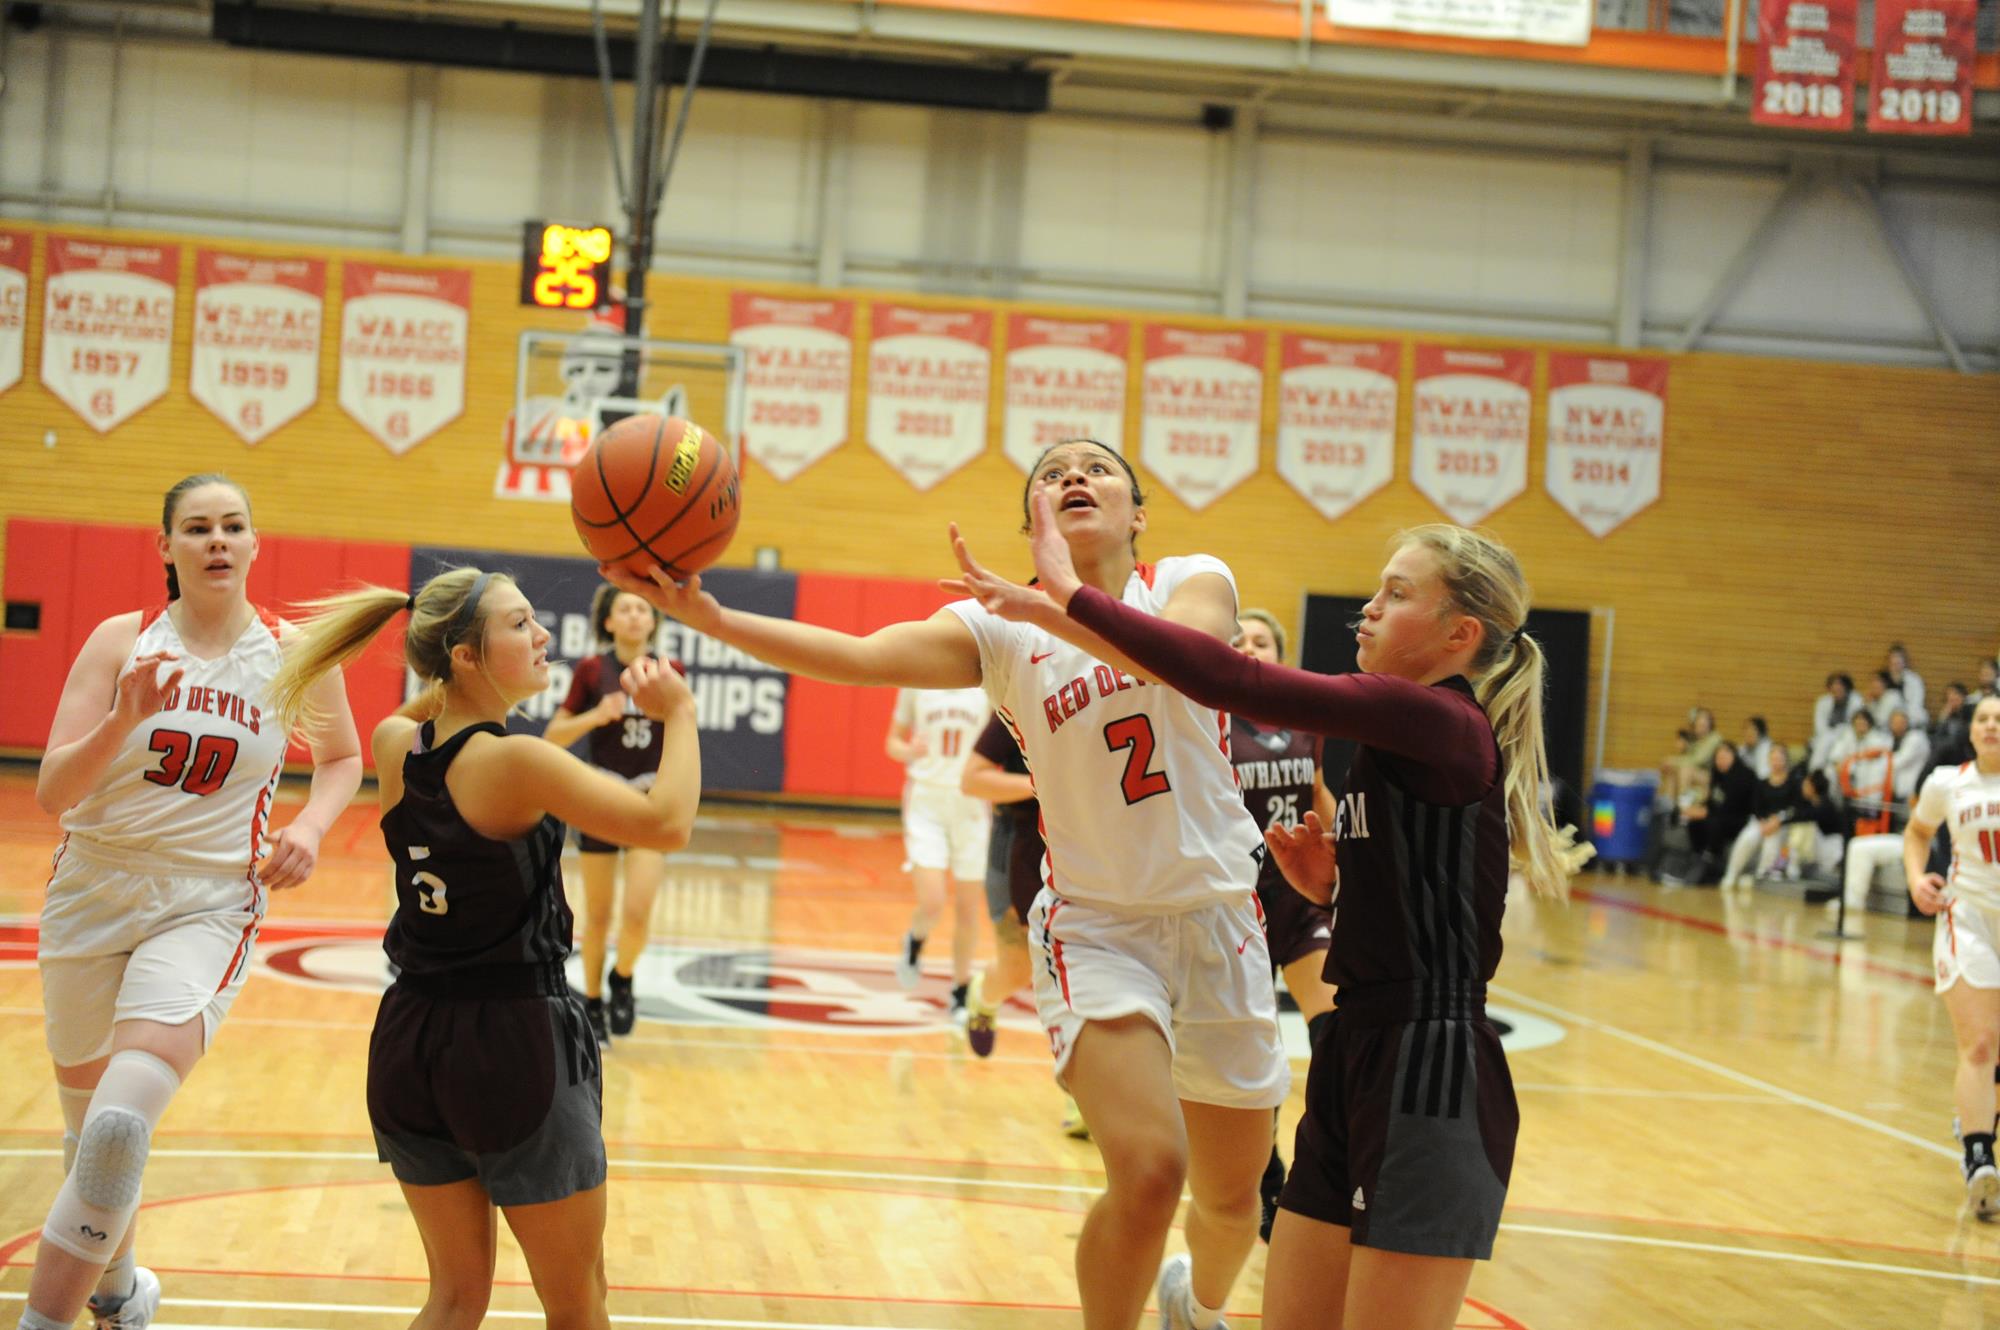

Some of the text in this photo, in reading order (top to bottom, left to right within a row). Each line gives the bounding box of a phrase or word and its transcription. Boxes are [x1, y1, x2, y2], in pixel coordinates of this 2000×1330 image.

[1763, 81, 1843, 118] 2018
[1879, 88, 1961, 124] 2019
[534, 254, 597, 308] 25
[1571, 457, 1632, 487] 2014
[186, 686, 262, 736] DEVILS
[1043, 676, 1091, 734] RED
[621, 717, 652, 749] 35
[143, 728, 239, 796] 30
[1103, 713, 1172, 806] 2
[1236, 757, 1316, 790] WHATCO
[1267, 794, 1299, 832] 25
